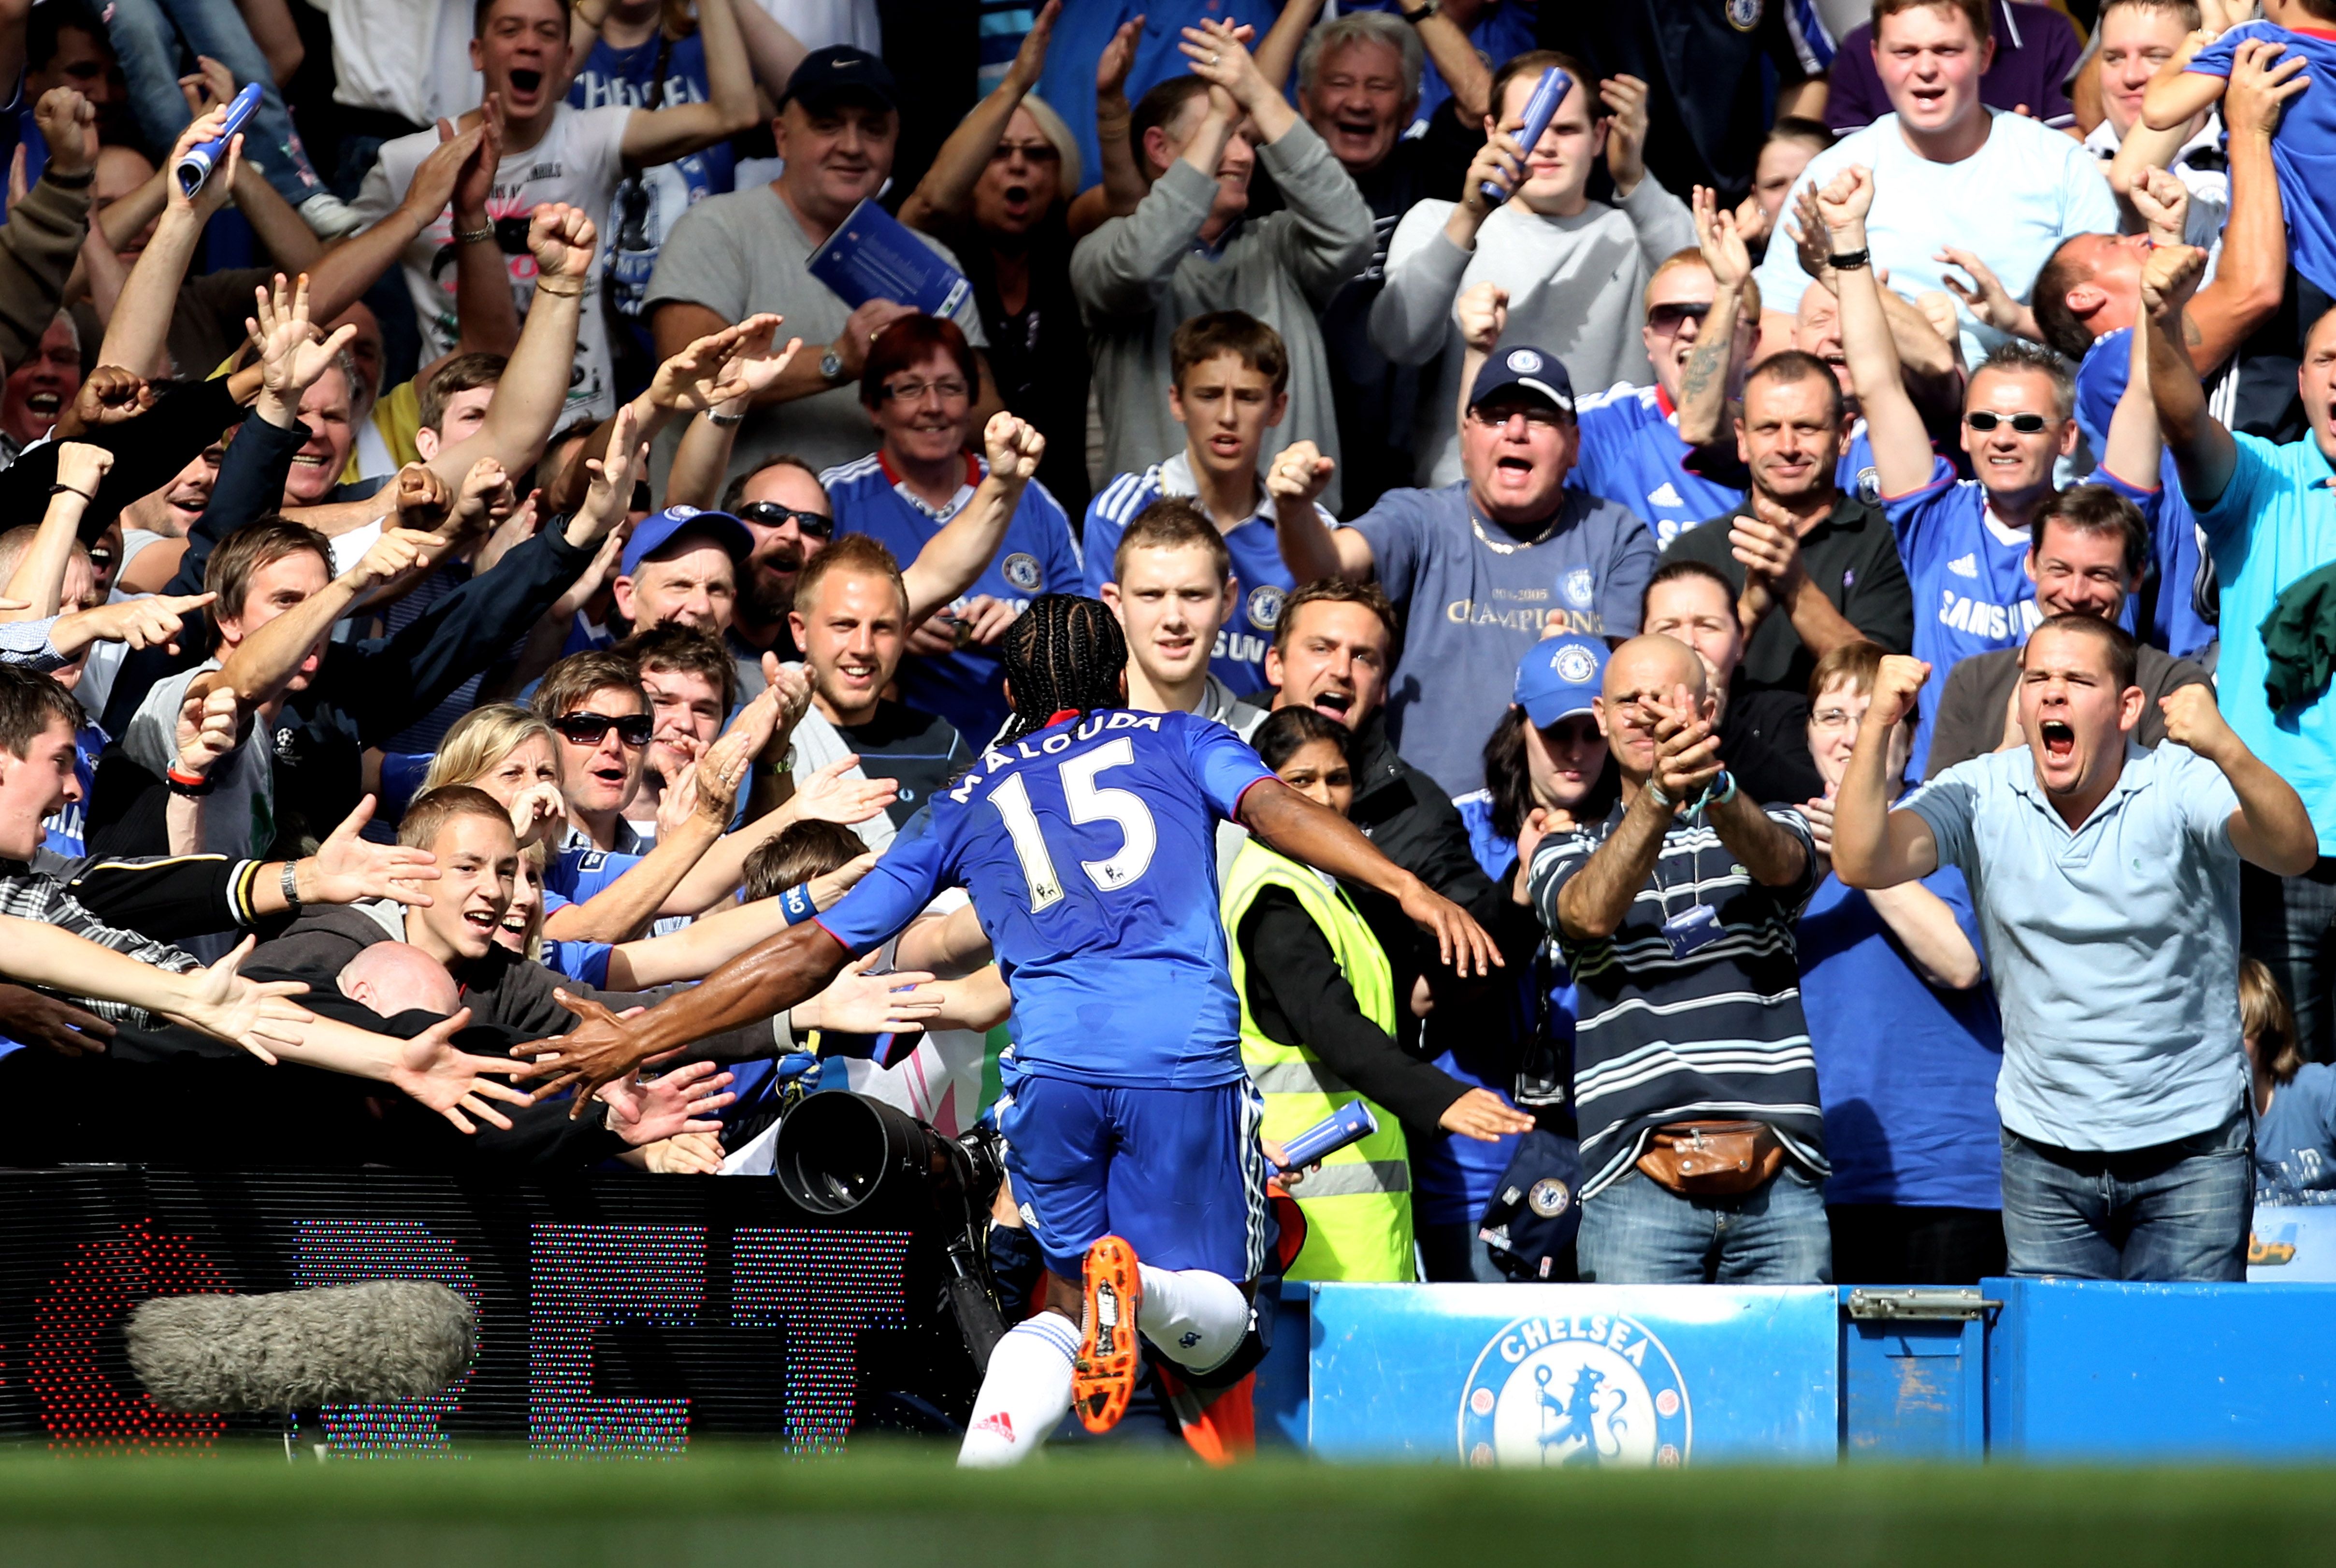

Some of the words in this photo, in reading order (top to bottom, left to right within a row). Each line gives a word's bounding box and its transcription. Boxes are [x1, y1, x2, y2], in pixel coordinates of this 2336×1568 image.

[574, 71, 706, 110] HELEA
[1939, 589, 2044, 641] SAMSUN
[949, 712, 1161, 805] MALOUDA
[986, 736, 1157, 914] 15
[1500, 1314, 1649, 1367] CHELSEA
